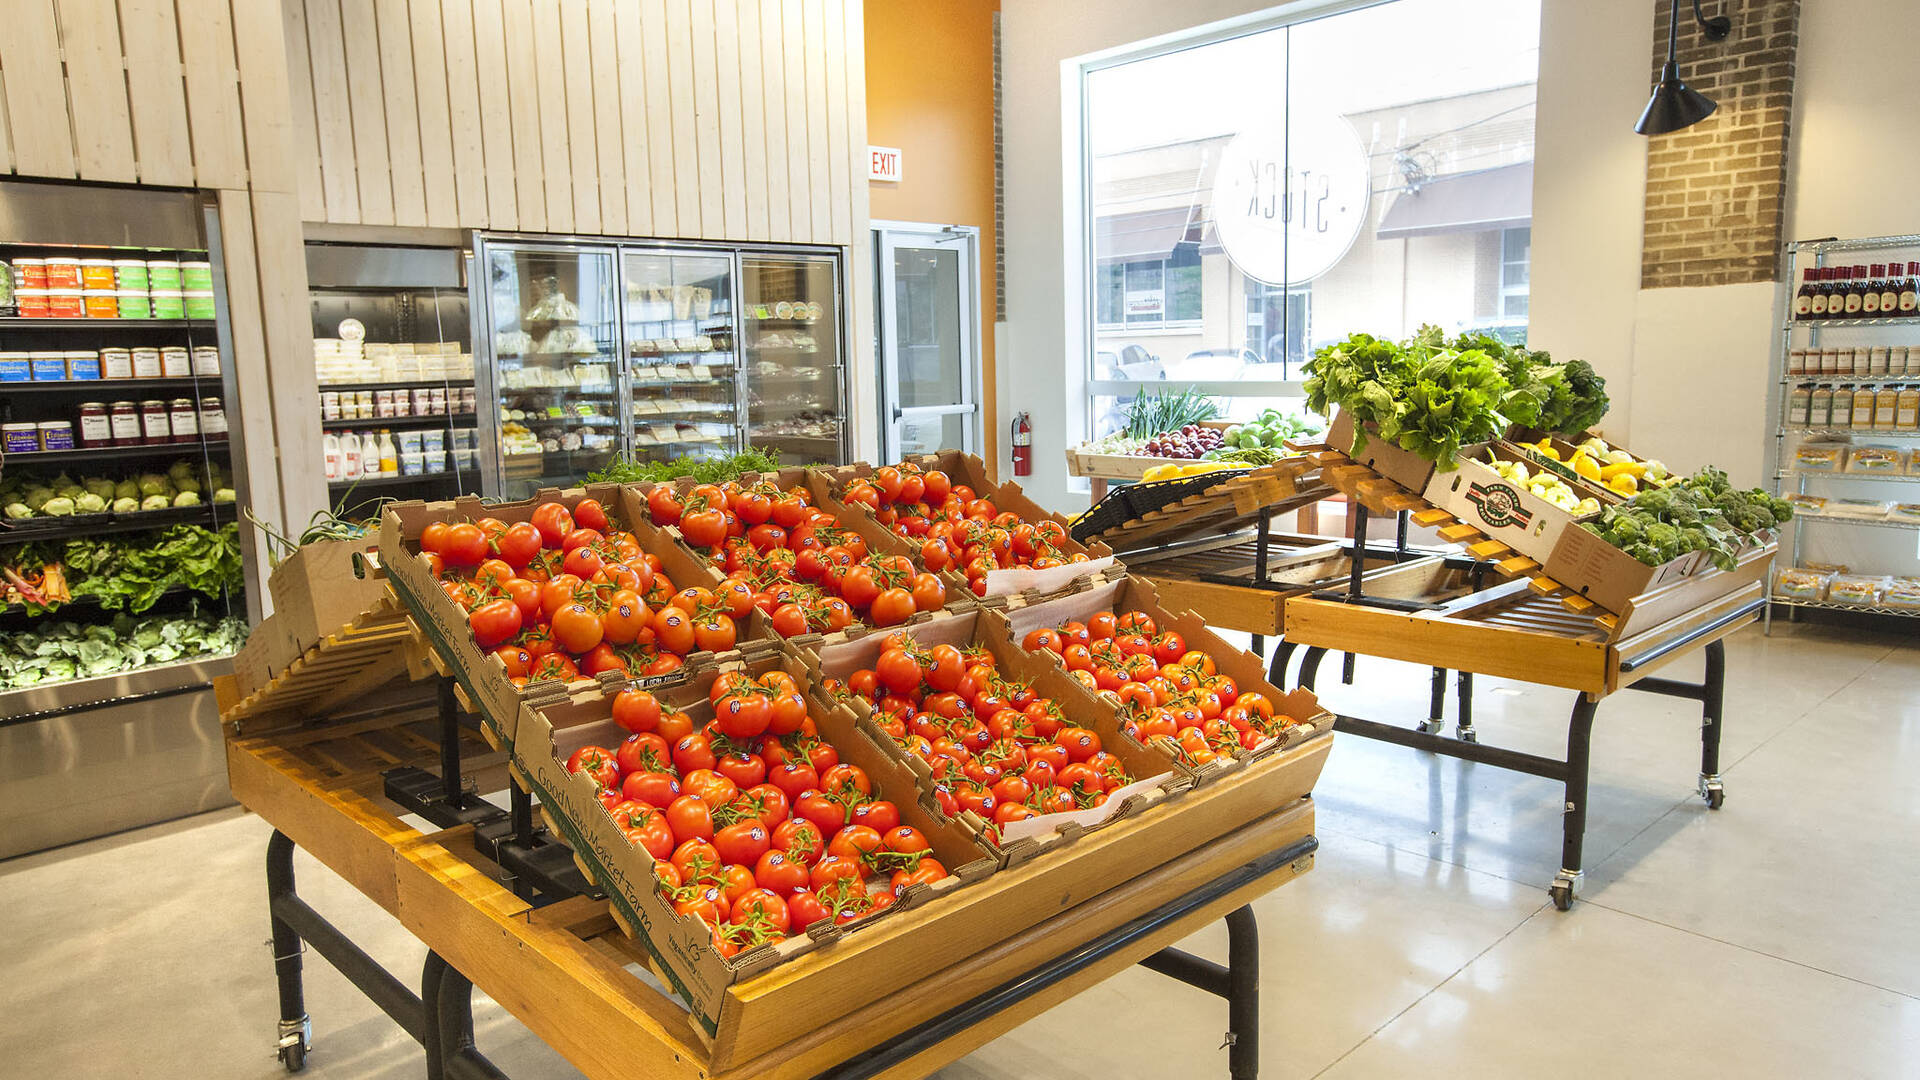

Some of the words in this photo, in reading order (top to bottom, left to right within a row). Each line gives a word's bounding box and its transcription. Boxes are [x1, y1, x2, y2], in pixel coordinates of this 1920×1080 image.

[872, 151, 897, 176] EXIT
[1478, 503, 1511, 526] VEGETABLES
[624, 879, 652, 932] Farm
